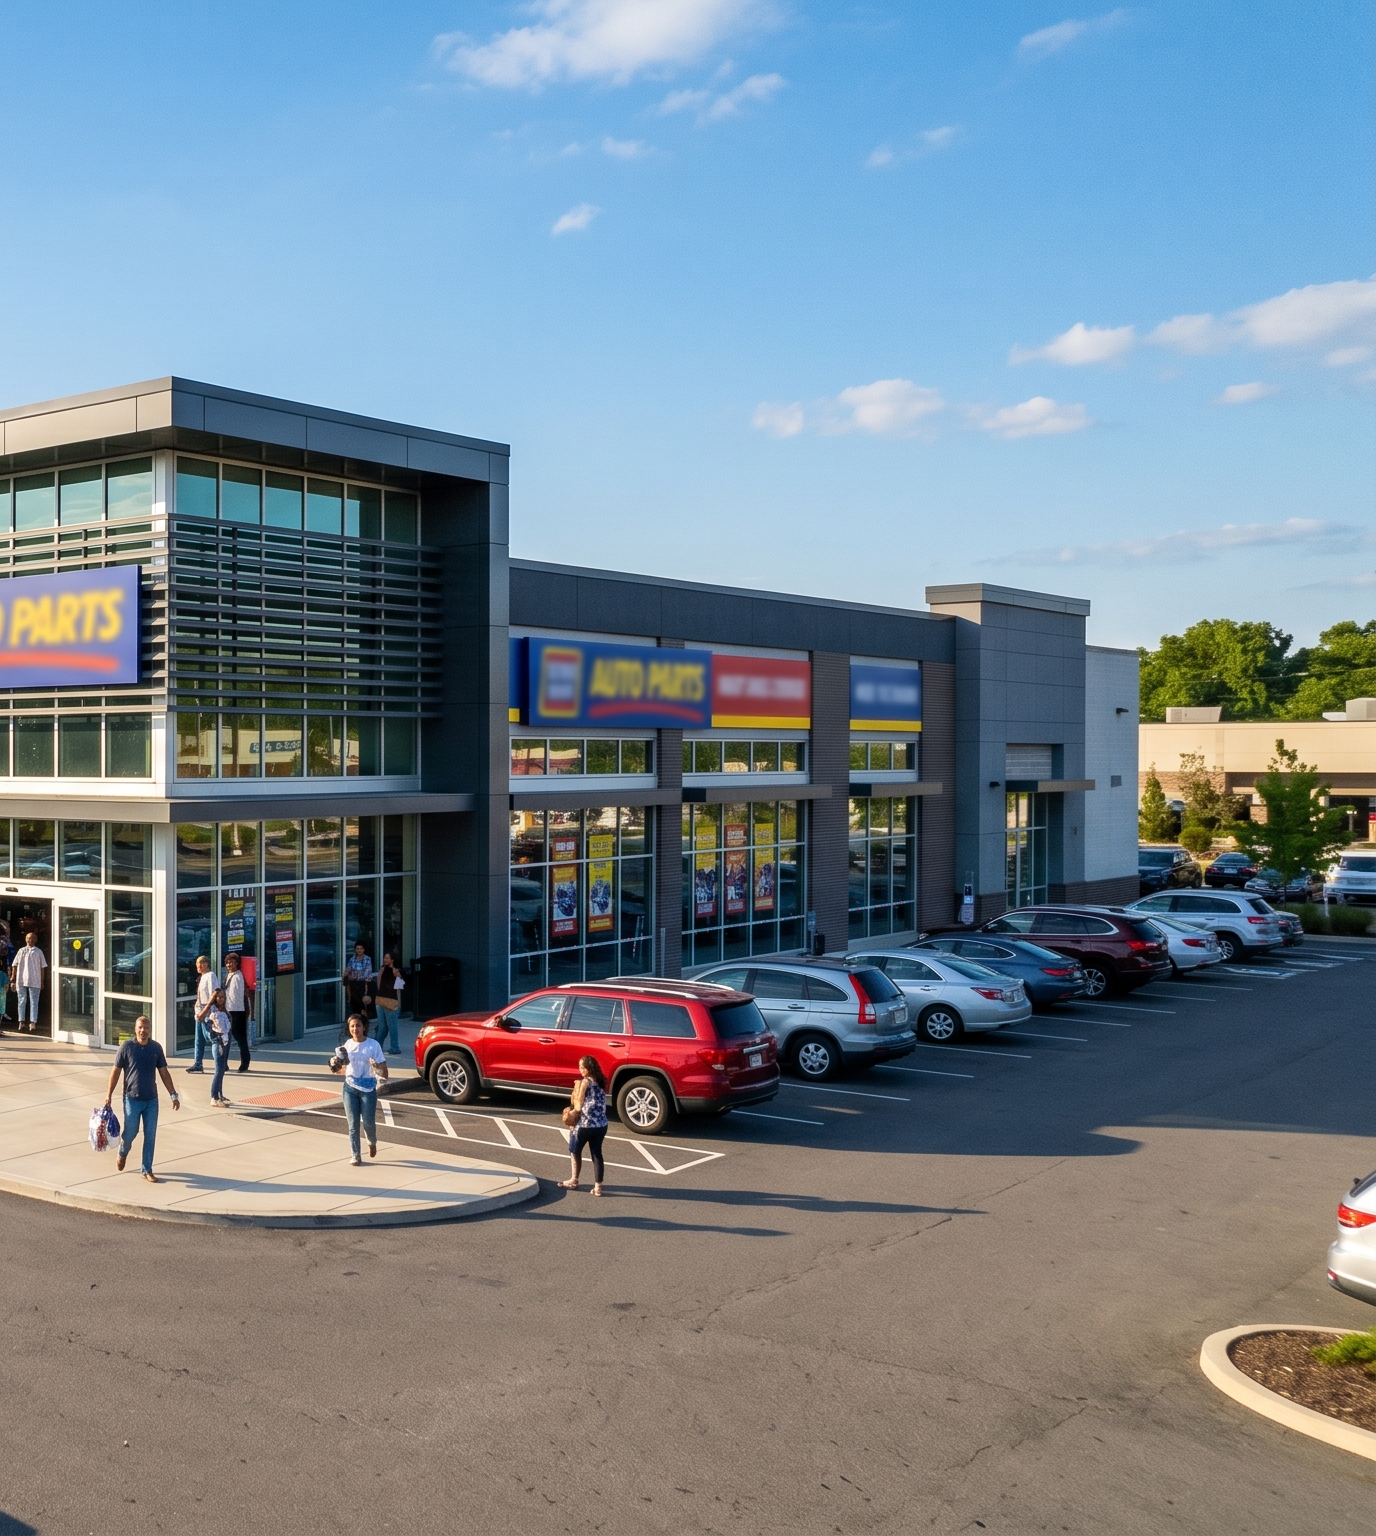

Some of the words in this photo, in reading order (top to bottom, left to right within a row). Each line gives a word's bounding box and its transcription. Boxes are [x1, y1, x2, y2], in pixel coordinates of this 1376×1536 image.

[10, 590, 123, 645] PARTS
[590, 659, 643, 698] AUTO
[648, 661, 705, 702] PARTS
